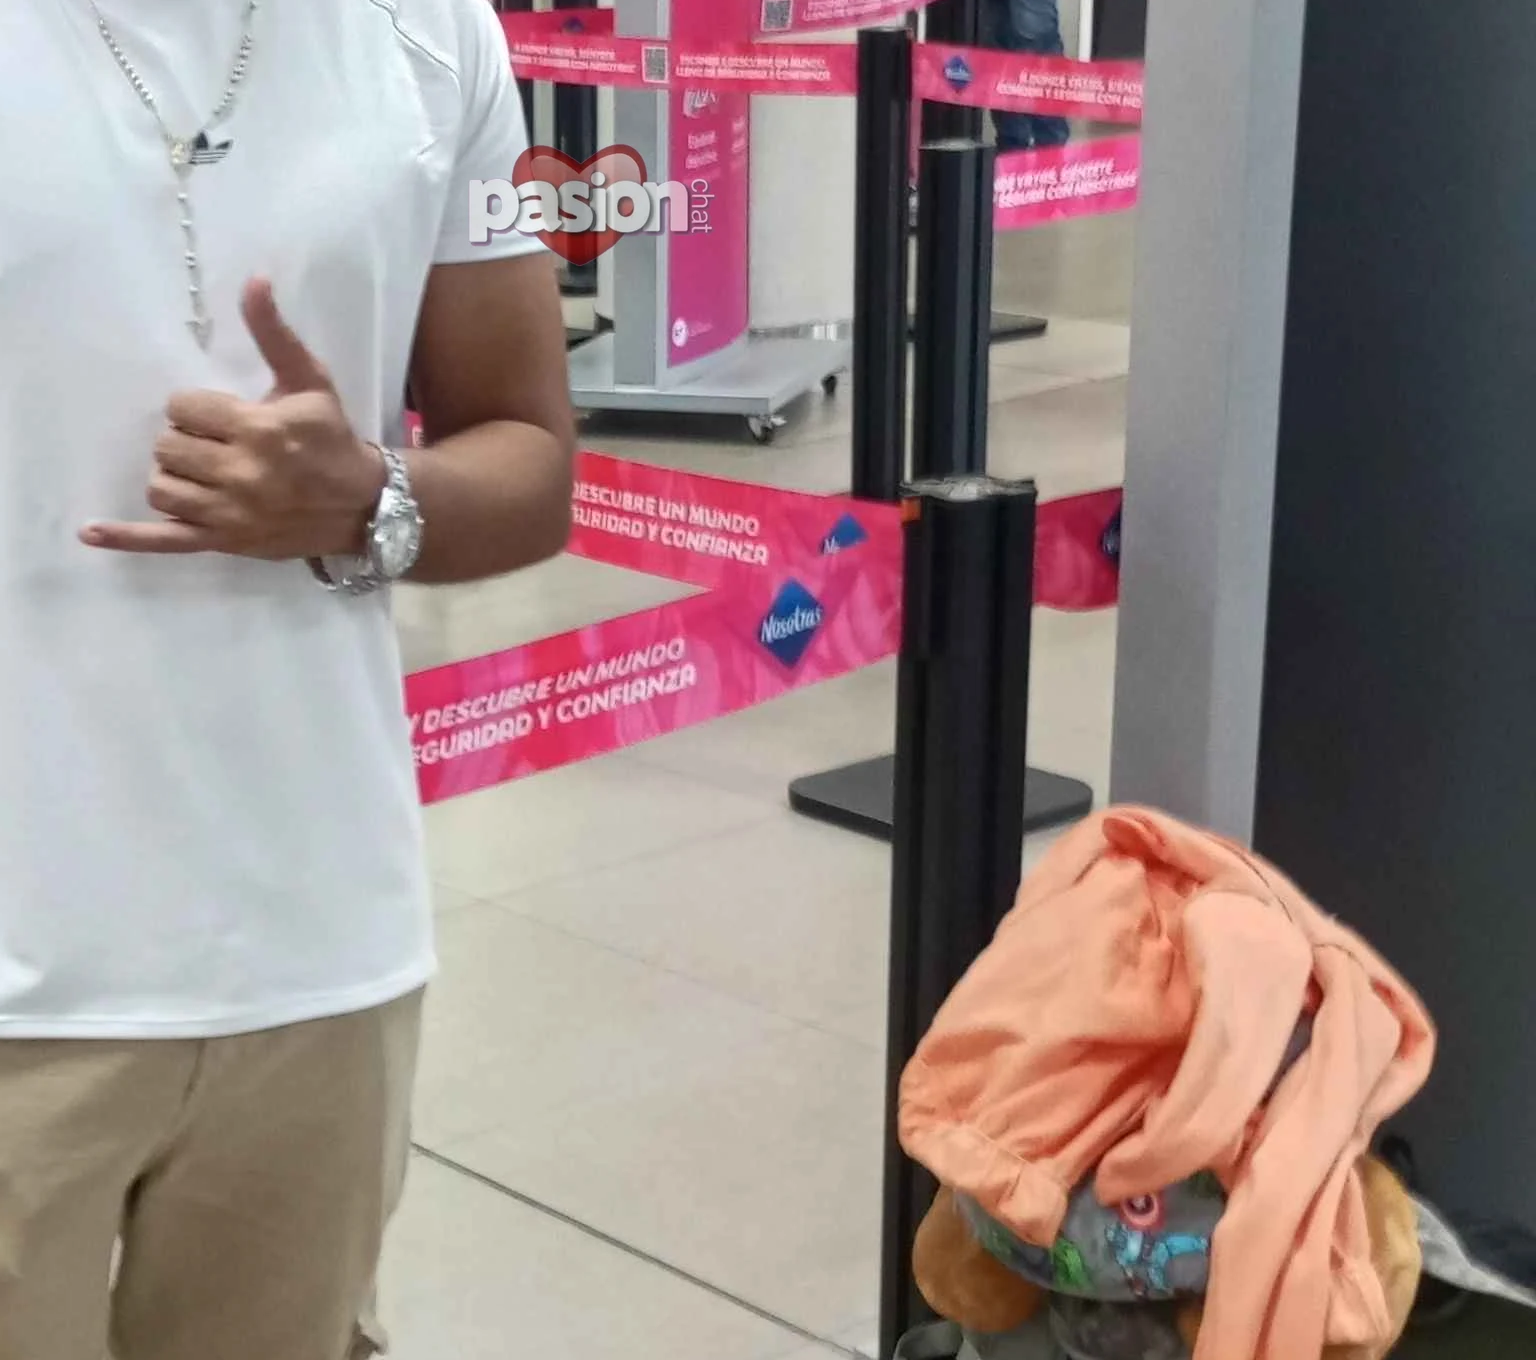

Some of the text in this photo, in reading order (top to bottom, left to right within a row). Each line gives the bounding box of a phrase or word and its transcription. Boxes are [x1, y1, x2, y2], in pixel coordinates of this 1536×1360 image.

[658, 498, 686, 523] UN
[687, 502, 761, 537] MUNDO
[646, 520, 660, 542] Y
[661, 525, 770, 567] CONFIANZA
[760, 604, 823, 644] Nosotras
[422, 676, 555, 735] DESCUBRE
[554, 663, 595, 695] UN
[594, 637, 687, 683] MUNDO
[536, 704, 555, 730] Y
[555, 663, 698, 725] CONFIANZA
